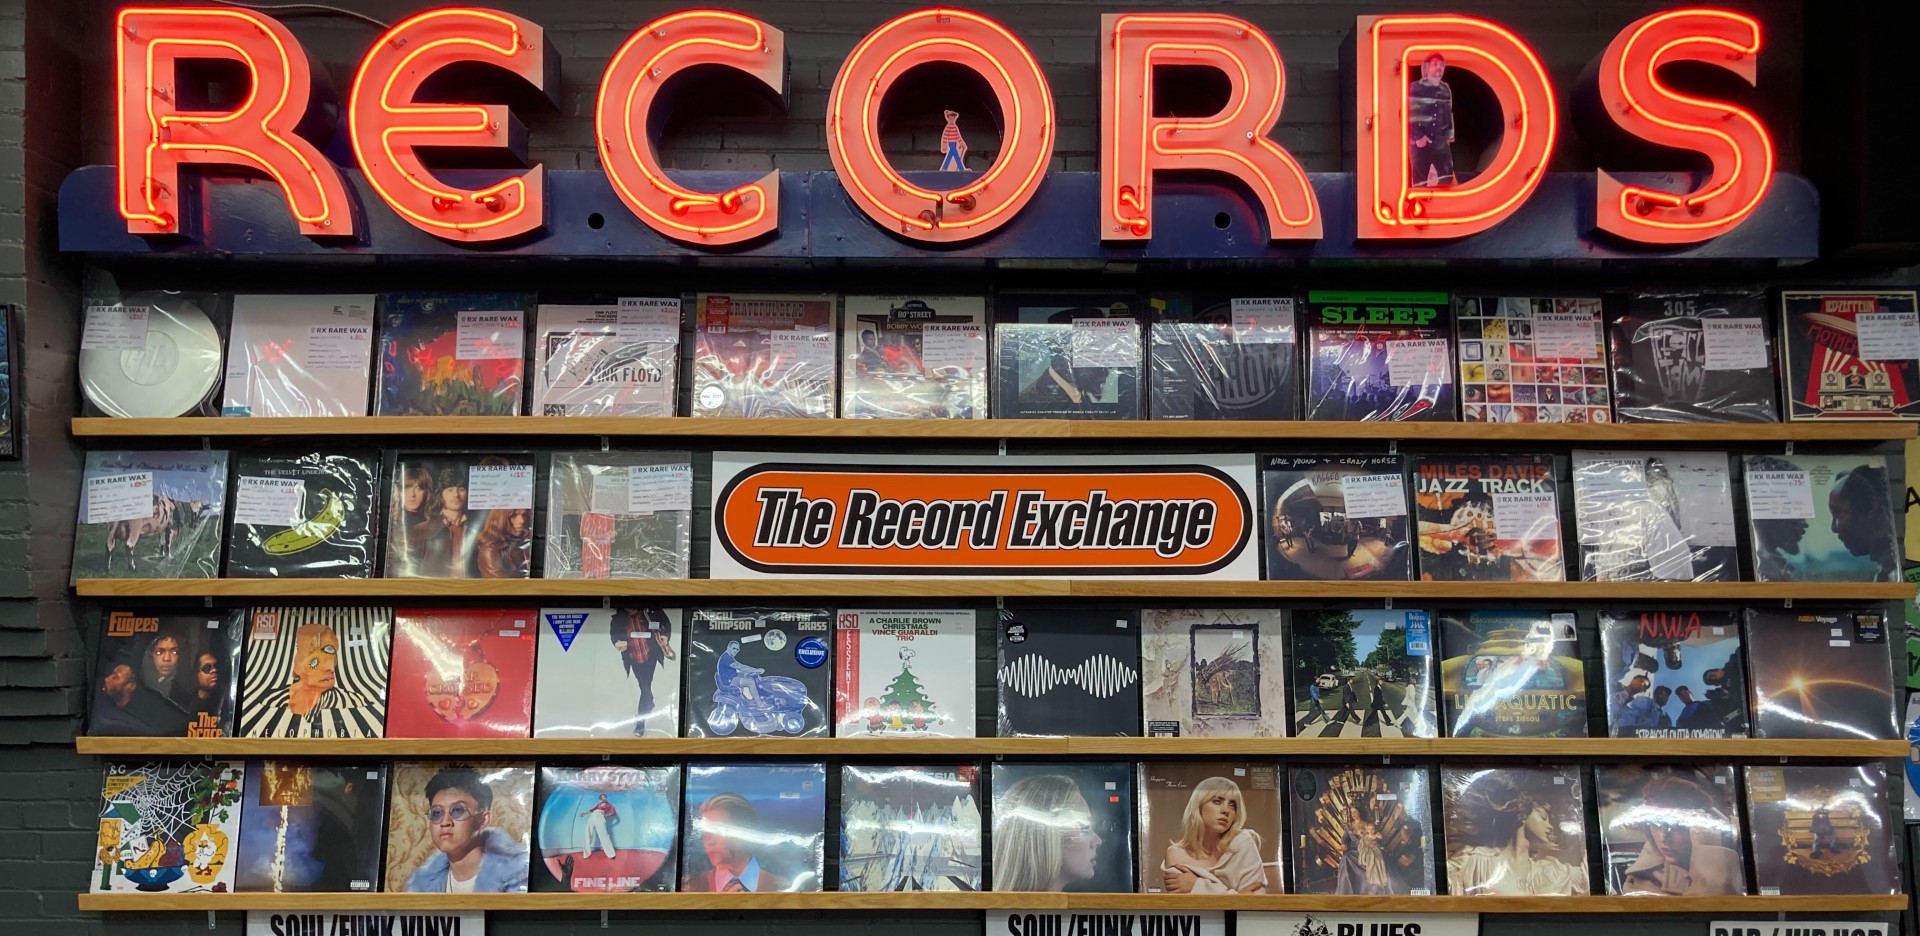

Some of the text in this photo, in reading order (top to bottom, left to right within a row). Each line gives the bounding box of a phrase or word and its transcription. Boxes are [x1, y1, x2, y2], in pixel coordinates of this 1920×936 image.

[116, 7, 1776, 245] RECORDS
[1321, 306, 1437, 325] SLEEP
[1663, 300, 1696, 316] 305
[1270, 458, 1290, 466] NEIL
[1293, 459, 1316, 467] YOUNG
[1340, 458, 1368, 468] CRAZY
[1420, 464, 1547, 480] MILES DAVIS
[1420, 478, 1545, 493] JAZZ TRACK
[752, 486, 837, 549] The
[838, 488, 1009, 550] Record
[1006, 489, 1219, 559] Exchange
[107, 611, 160, 638] Fugees
[256, 613, 275, 627] RSD
[709, 621, 828, 631] SIMPSON GRASS
[839, 614, 859, 630] RSD
[1815, 615, 1838, 624] Voyage
[799, 648, 825, 656] EXCLUSIVE
[1494, 694, 1577, 710] AQUATIC
[197, 711, 218, 728] The
[574, 877, 640, 888] FINE LINE
